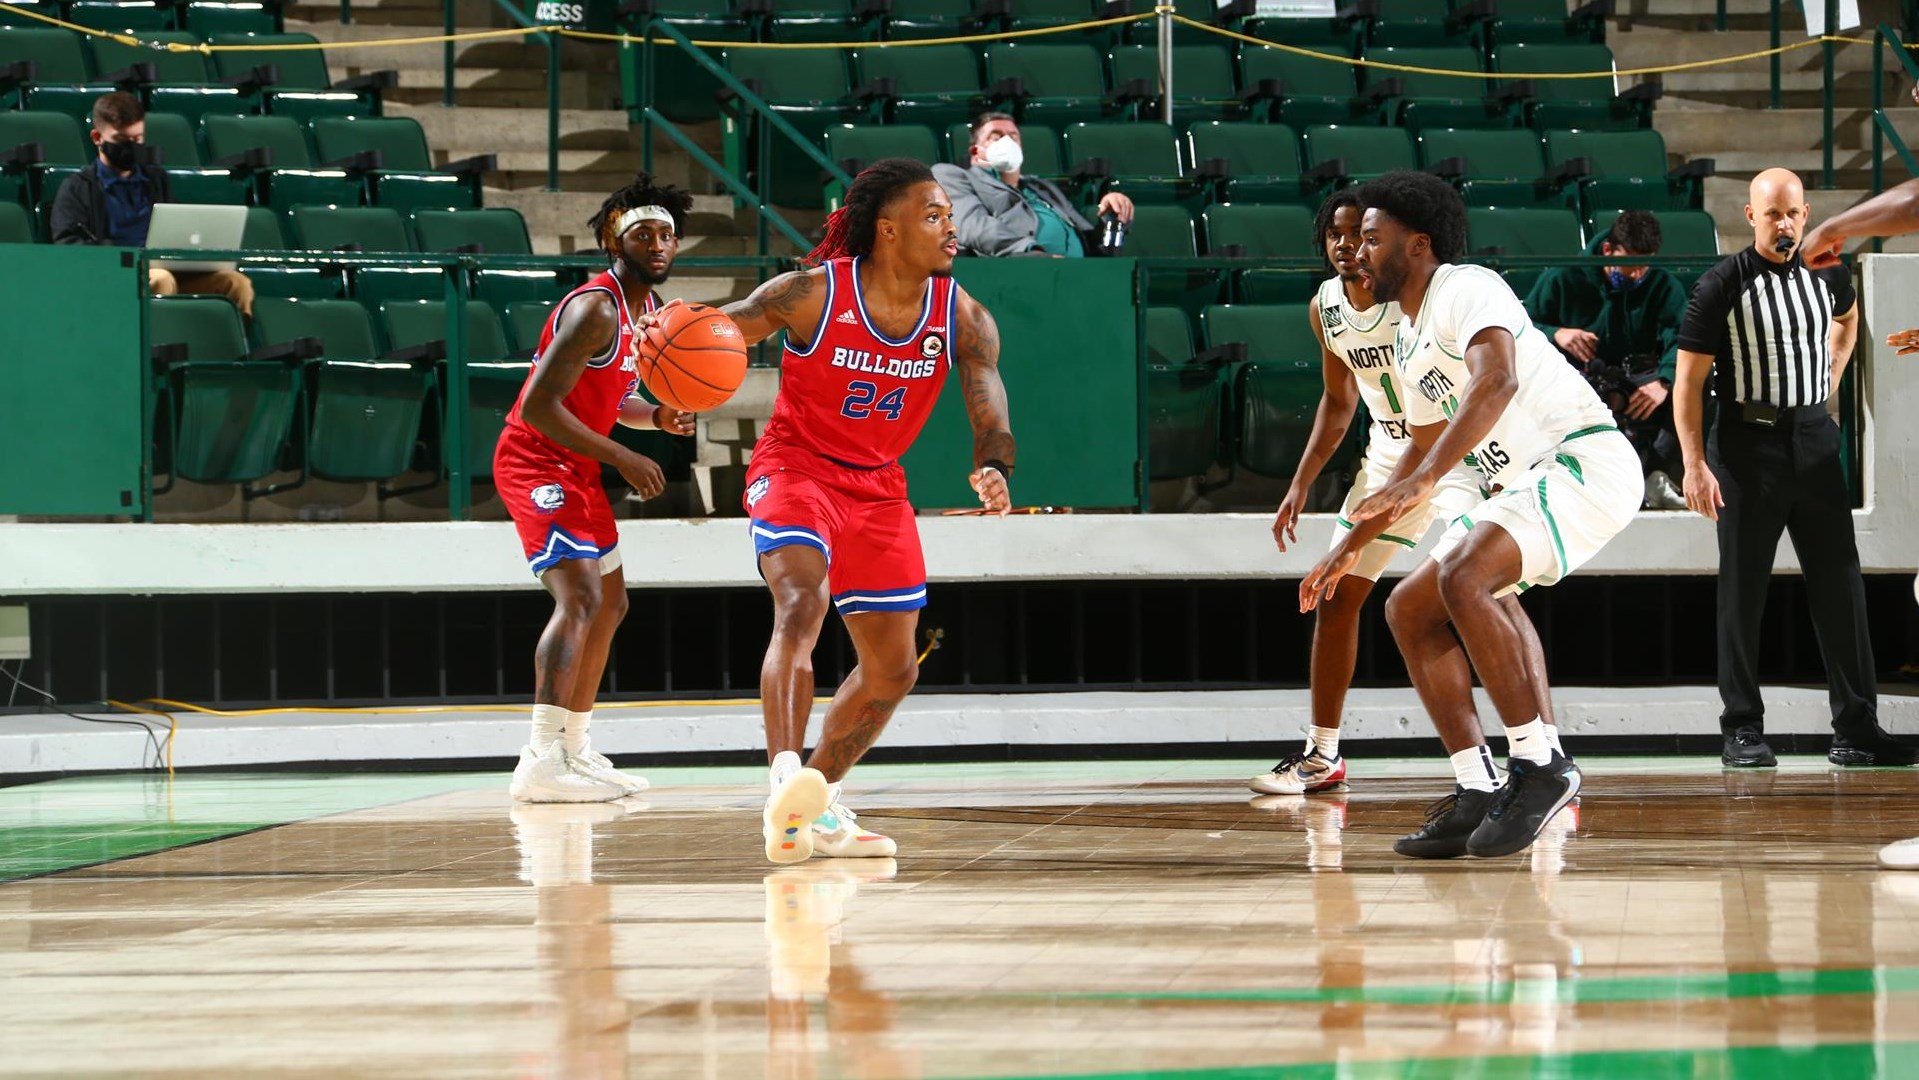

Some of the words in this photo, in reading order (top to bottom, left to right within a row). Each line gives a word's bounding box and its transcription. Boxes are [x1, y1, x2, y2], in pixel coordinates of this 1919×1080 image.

[836, 317, 858, 325] adidas
[831, 347, 936, 379] BULLDOGS
[840, 380, 908, 420] 24
[1380, 372, 1402, 413] 1
[1378, 419, 1411, 439] TEX
